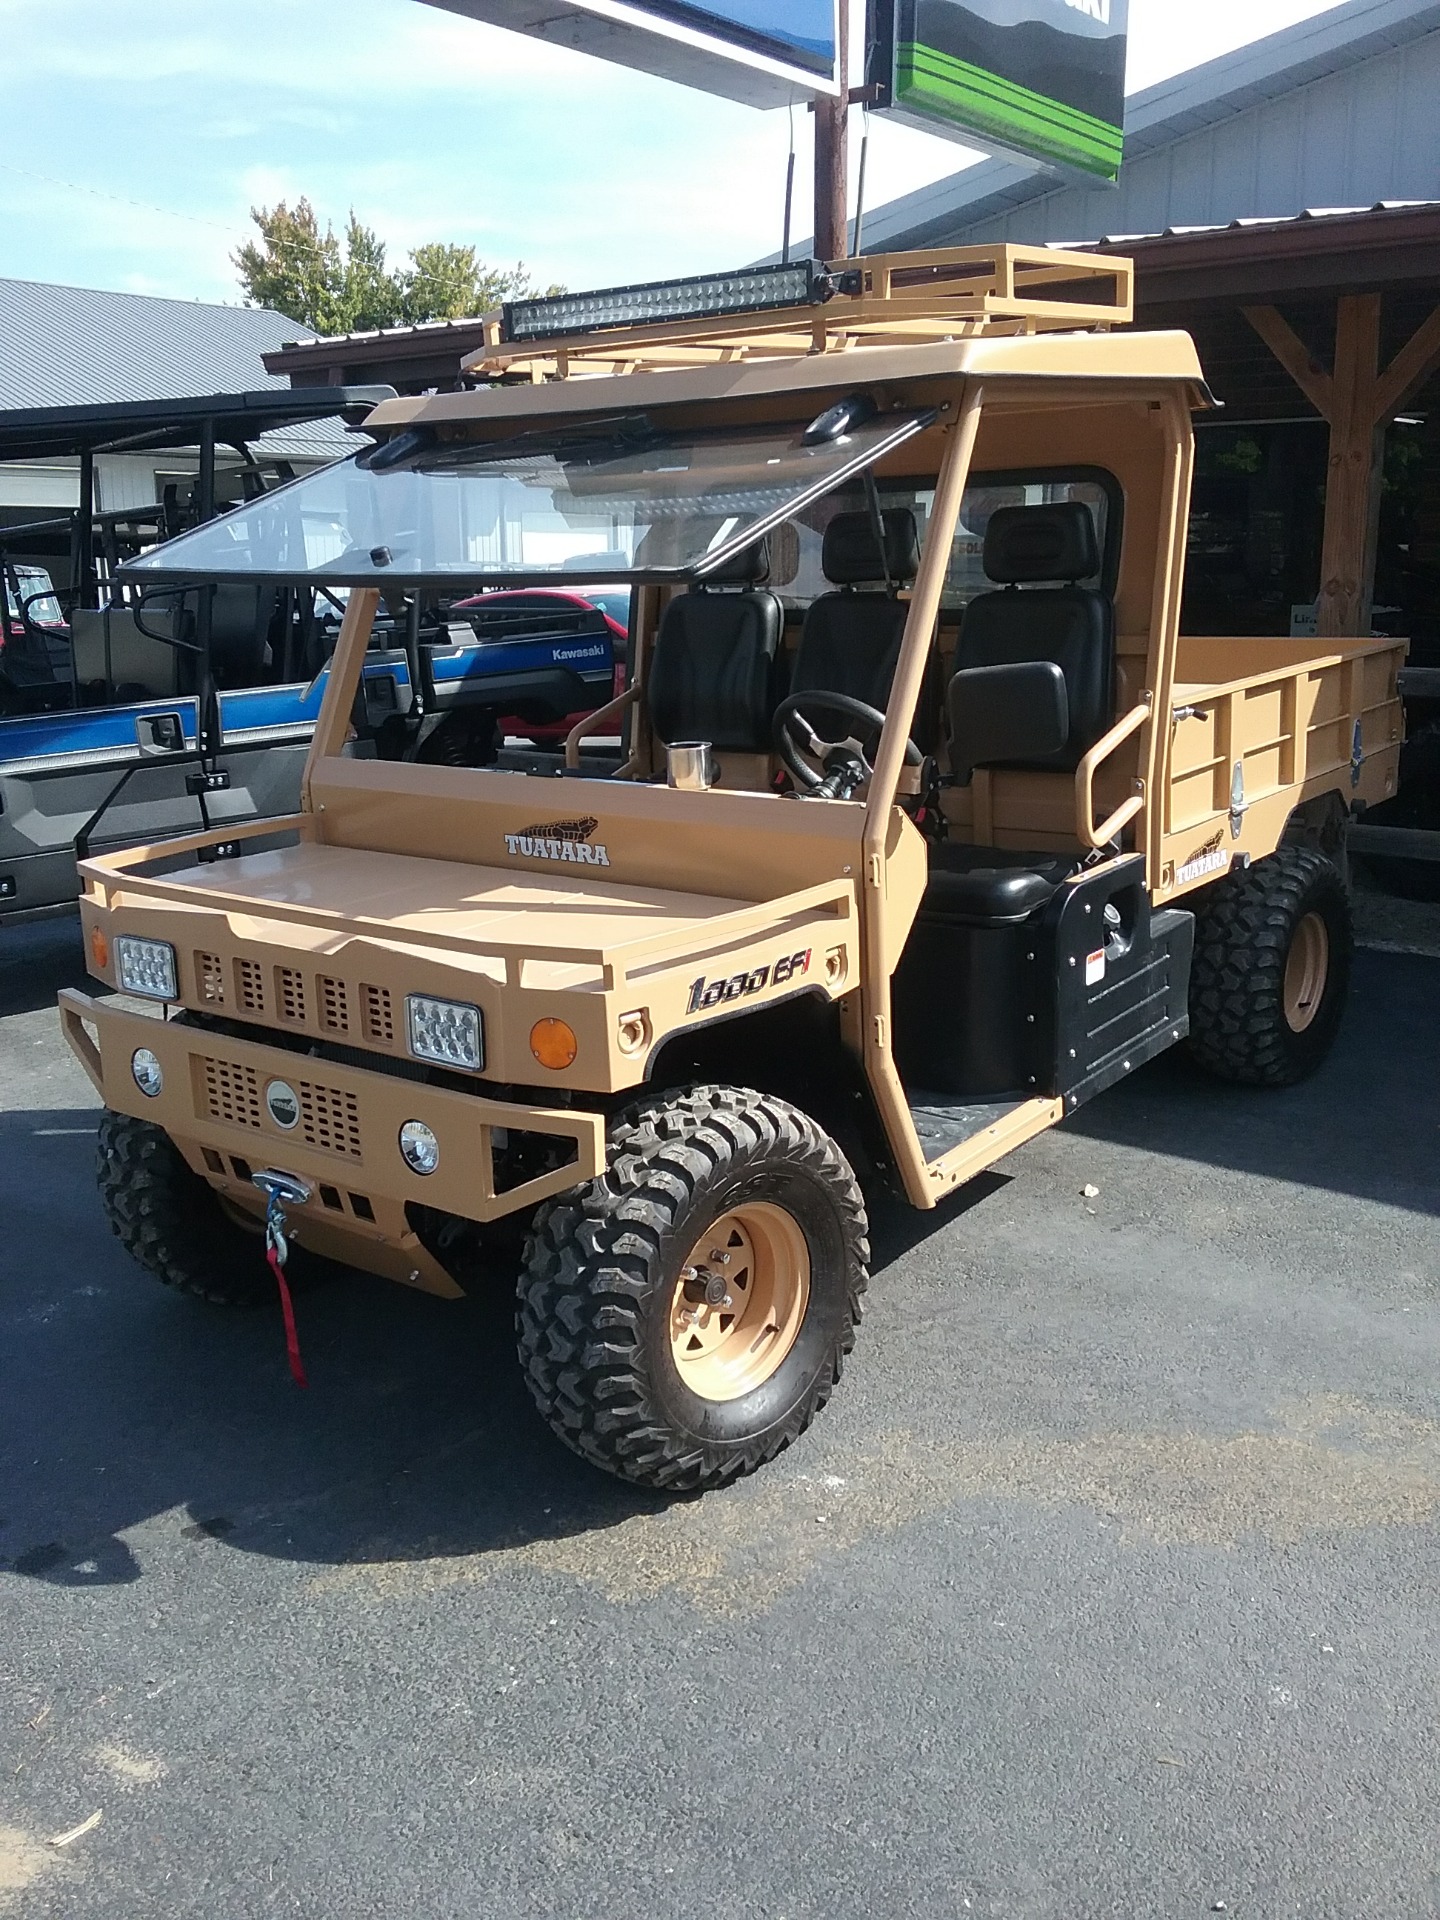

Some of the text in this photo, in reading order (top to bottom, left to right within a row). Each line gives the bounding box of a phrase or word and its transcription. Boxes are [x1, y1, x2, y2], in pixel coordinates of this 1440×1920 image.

[552, 644, 604, 660] Kawasaki
[504, 834, 610, 866] TUATARA
[1176, 848, 1228, 885] TUATARA
[685, 965, 771, 1015] 1000
